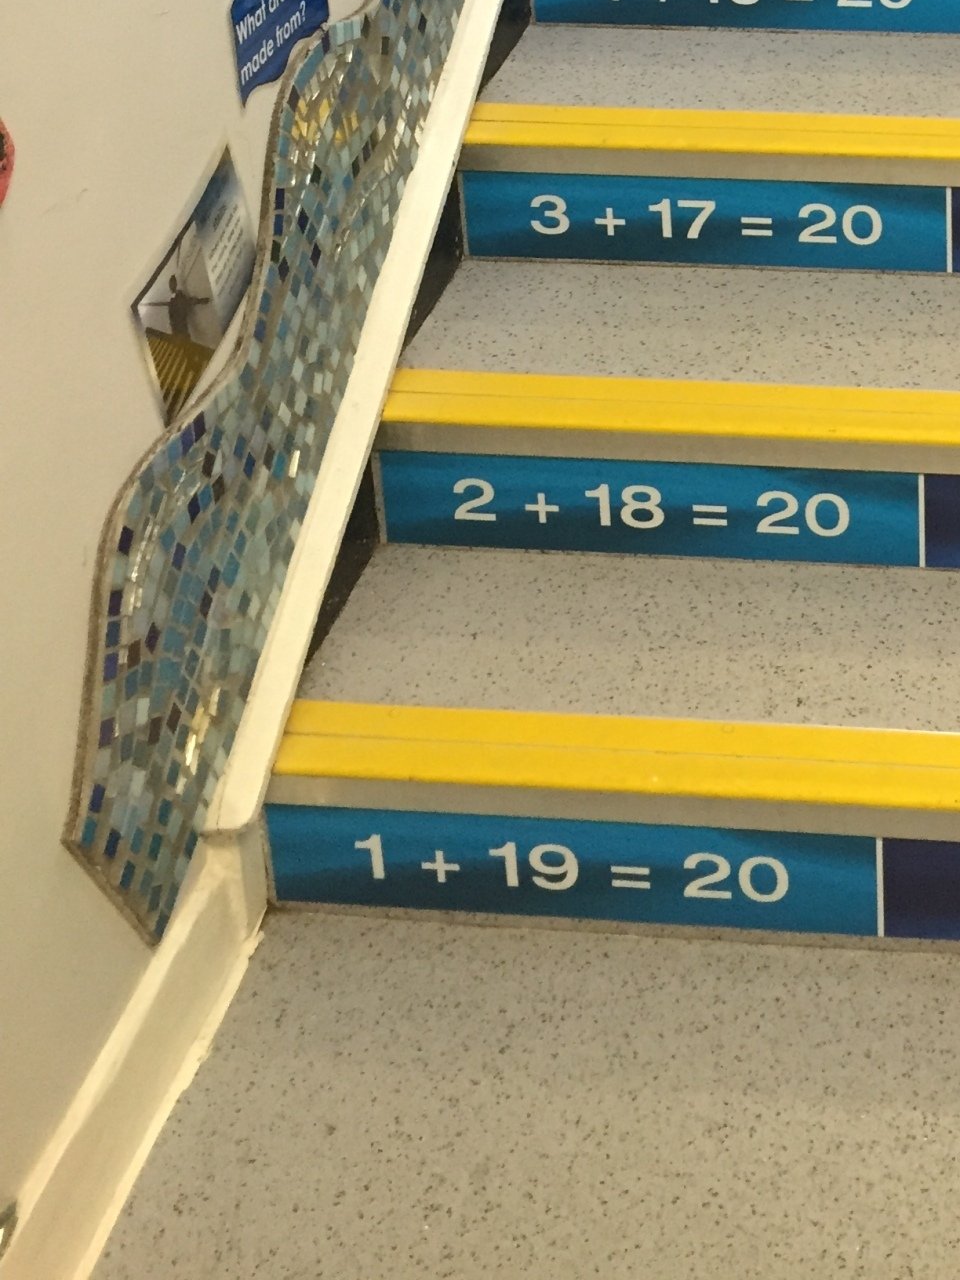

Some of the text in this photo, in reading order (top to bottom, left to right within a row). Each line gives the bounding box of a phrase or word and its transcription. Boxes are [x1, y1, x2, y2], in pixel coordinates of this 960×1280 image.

[235, 0, 267, 45] What
[240, 0, 306, 86] made from?
[530, 194, 883, 246] 3 + 17 = 20
[453, 478, 850, 537] 2 + 18 = 20
[354, 834, 789, 903] 1 + 19 = 20
